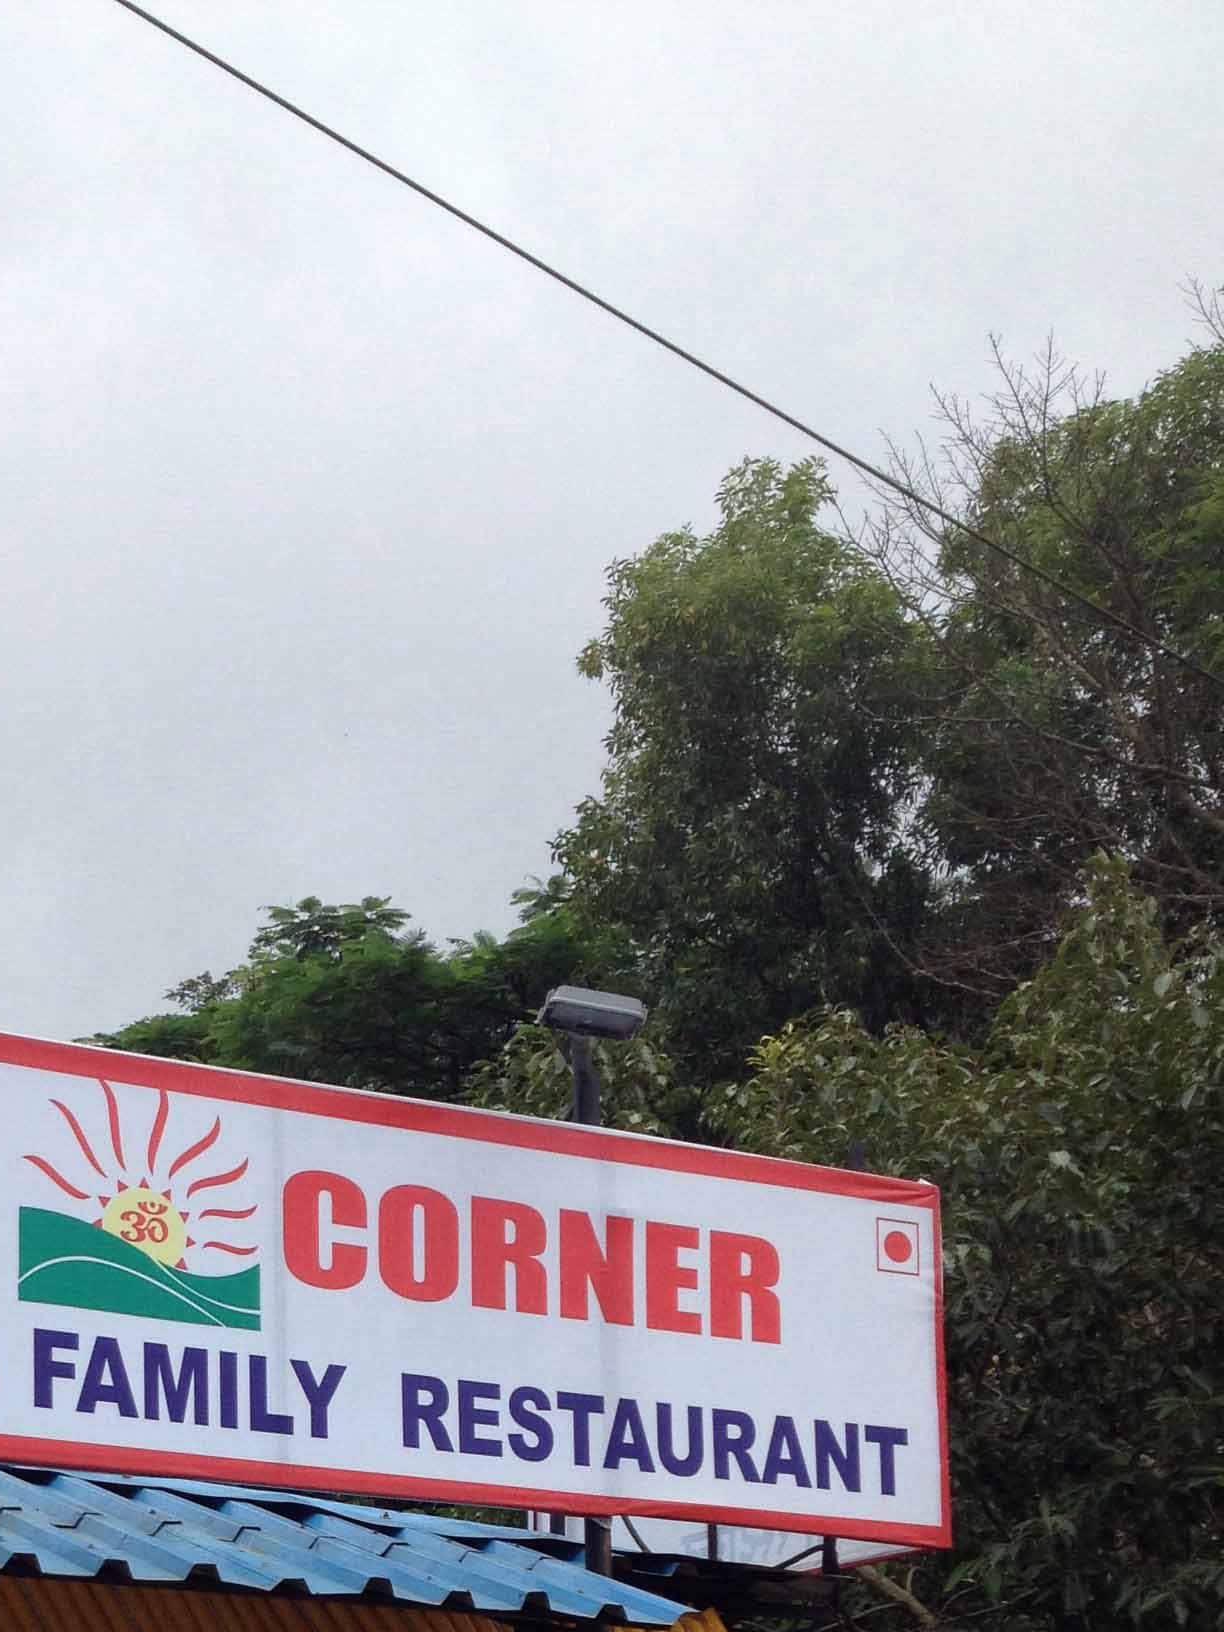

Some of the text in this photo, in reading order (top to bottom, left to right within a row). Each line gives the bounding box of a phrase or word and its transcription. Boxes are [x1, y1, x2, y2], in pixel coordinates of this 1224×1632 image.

[283, 1170, 781, 1345] CORNER
[33, 1328, 347, 1439] FAMILY
[401, 1373, 908, 1496] RESTAURANT
